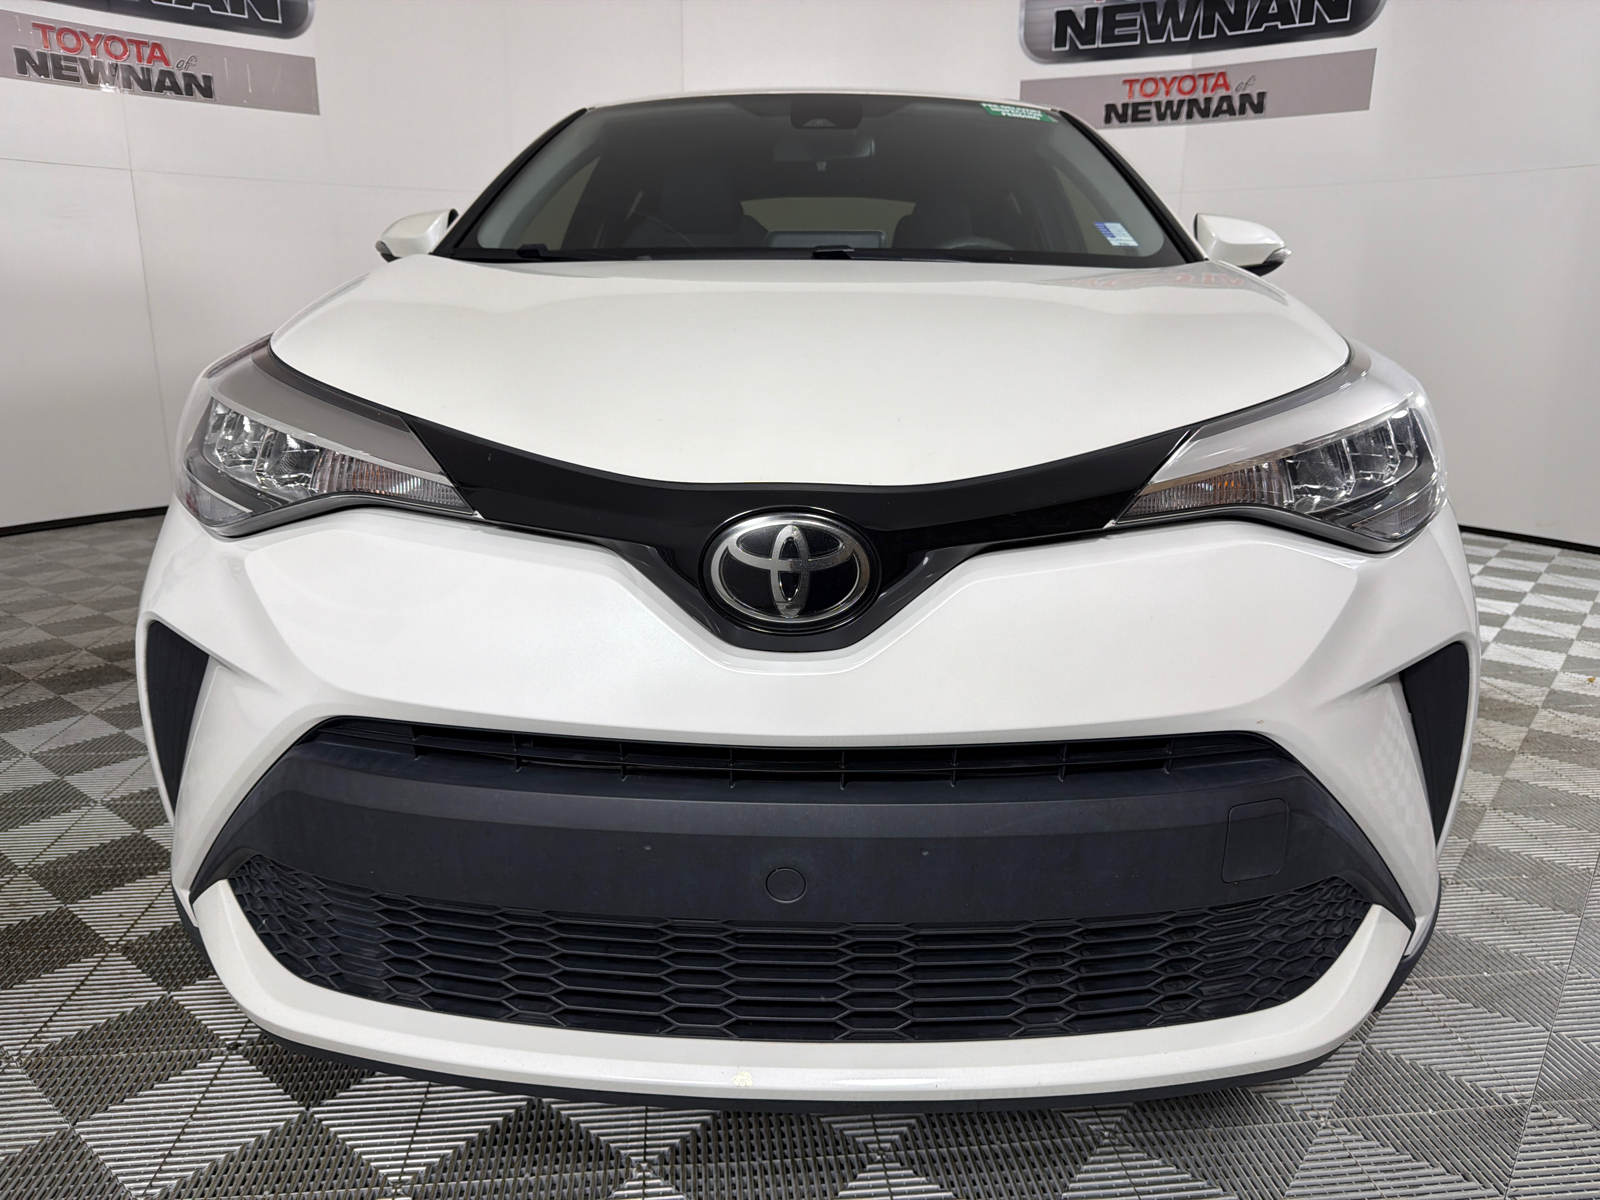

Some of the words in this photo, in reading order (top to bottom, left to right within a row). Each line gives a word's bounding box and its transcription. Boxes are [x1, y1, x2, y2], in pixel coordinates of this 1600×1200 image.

[31, 21, 171, 68] TOYOTA
[176, 55, 198, 71] of
[1051, 0, 1351, 51] NEWNAN
[12, 46, 215, 99] NEWNAN
[1122, 71, 1231, 99] TOYOTA
[1235, 75, 1256, 93] of
[1104, 91, 1267, 124] NEWNAN
